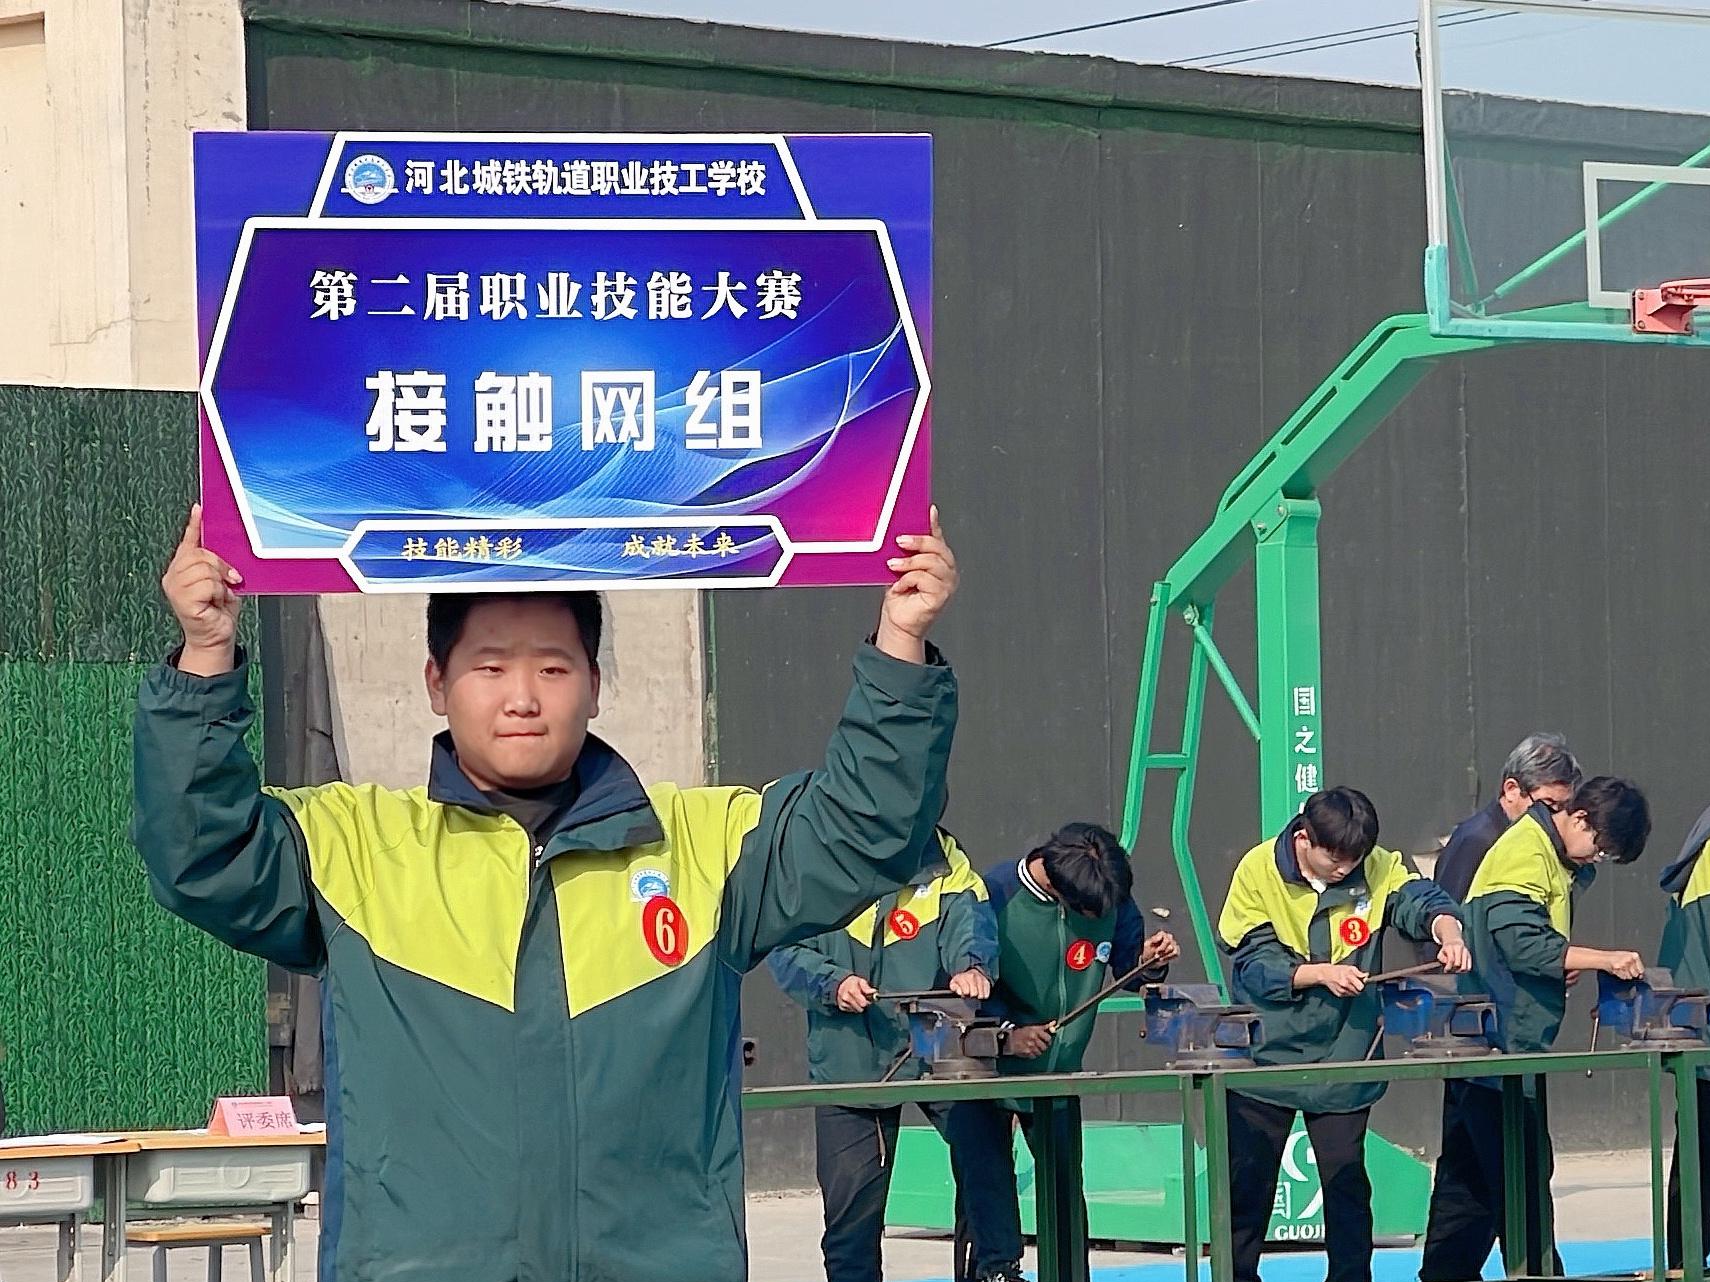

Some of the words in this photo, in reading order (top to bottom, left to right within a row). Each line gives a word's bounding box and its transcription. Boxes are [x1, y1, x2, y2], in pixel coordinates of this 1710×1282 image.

[404, 159, 767, 197] 河北城铁轨道职业技工学校
[309, 270, 803, 322] 第二届职业技能大赛
[364, 370, 763, 454] 接触网组
[401, 536, 523, 561] 技能精彩
[621, 533, 741, 558] 成就未来
[655, 907, 676, 955] 6
[895, 913, 914, 936] 5
[1347, 920, 1362, 942] 3
[1072, 944, 1086, 965] 4
[237, 1111, 293, 1129] 评委席
